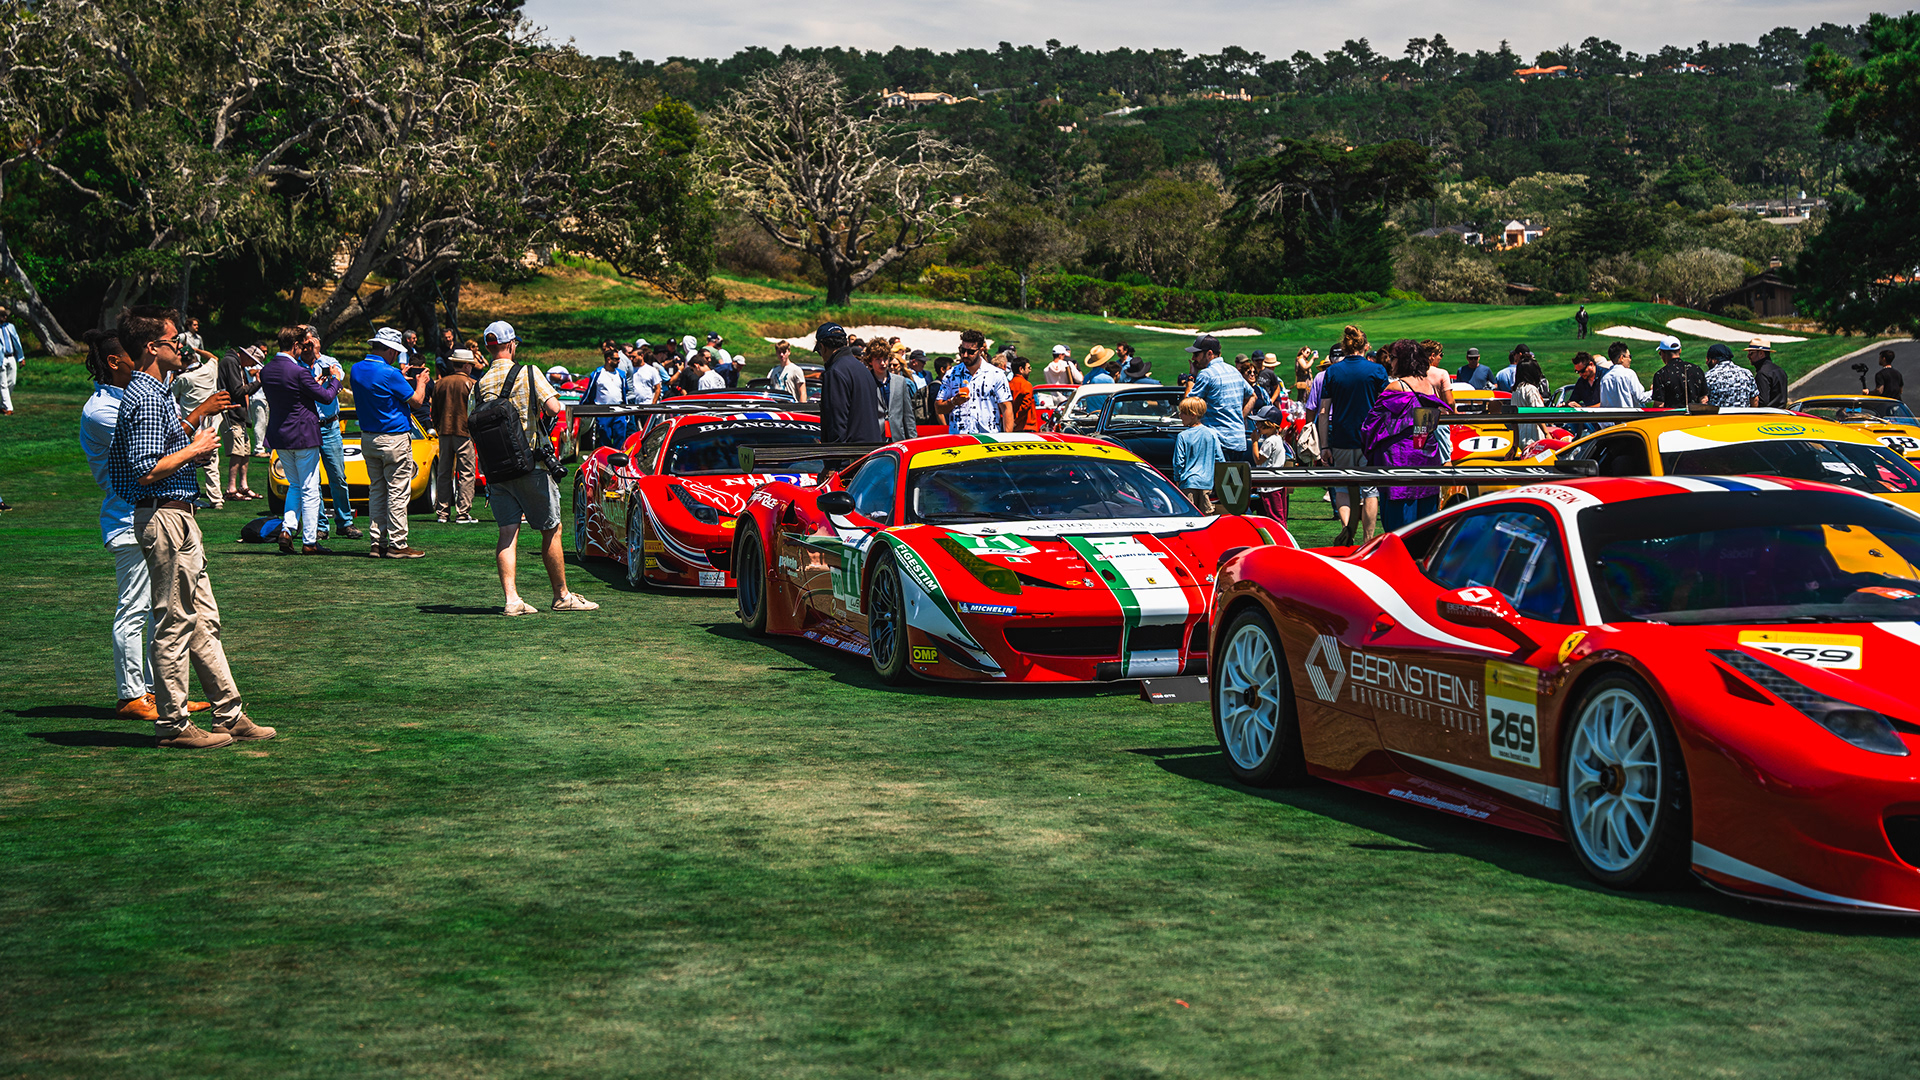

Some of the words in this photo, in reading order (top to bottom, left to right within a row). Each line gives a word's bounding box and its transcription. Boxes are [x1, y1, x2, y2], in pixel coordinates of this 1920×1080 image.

[698, 421, 821, 433] BLANCPAIN
[1763, 424, 1800, 432] intel
[983, 442, 1075, 453] Ferrari
[1469, 437, 1499, 449] 11
[1027, 522, 1093, 531] AUCTION
[951, 533, 1021, 549] 71
[843, 549, 861, 596] 71
[897, 544, 938, 590] FIGESTIM
[970, 604, 1014, 614] MICHELIN
[913, 649, 938, 660] OMP
[1351, 651, 1474, 709] BERNSTEIN
[1490, 708, 1535, 753] 269
